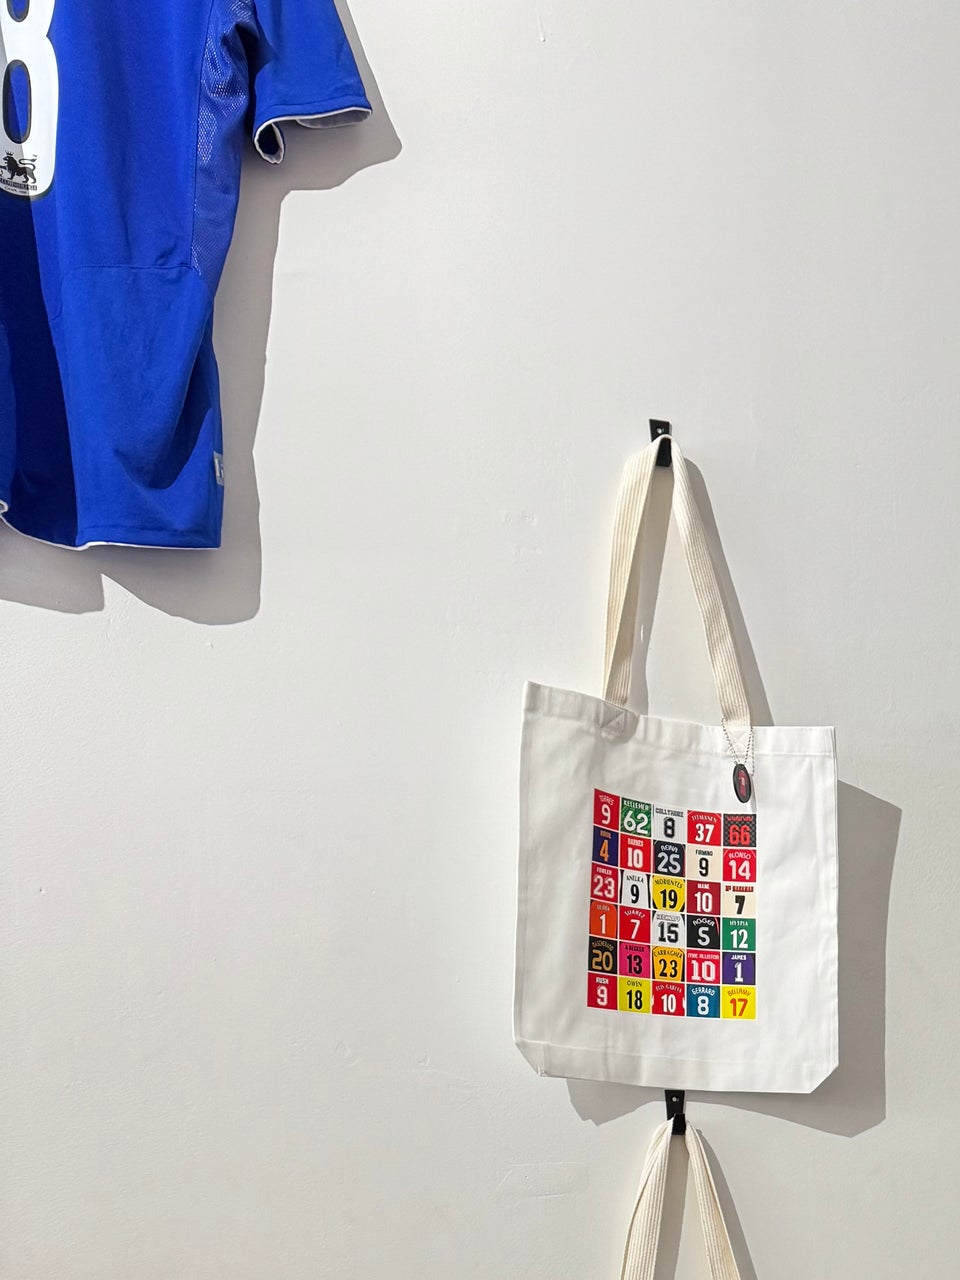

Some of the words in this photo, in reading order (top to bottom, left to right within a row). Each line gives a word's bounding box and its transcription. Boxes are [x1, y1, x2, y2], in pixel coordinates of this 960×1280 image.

[602, 804, 611, 825] 9
[624, 811, 649, 835] 62
[664, 817, 675, 838] 8
[695, 823, 714, 843] 37
[729, 824, 751, 846] 66
[600, 840, 609, 862] 4
[627, 847, 643, 869] 10
[728, 852, 751, 860] ALONSO
[657, 852, 681, 874] 25
[699, 857, 709, 877] 9
[729, 860, 751, 880] 14
[594, 874, 614, 898] 23
[630, 884, 640, 904] 9
[660, 888, 678, 909] 19
[695, 891, 713, 913] 10
[735, 895, 746, 915] 7
[600, 913, 607, 935] 1
[630, 919, 640, 939] 7
[657, 921, 679, 943] 15
[697, 927, 710, 946] 5
[730, 928, 748, 948] 12
[592, 949, 613, 971] 20
[626, 954, 643, 975] 13
[658, 959, 677, 978] 23
[691, 960, 715, 982] 10
[734, 962, 743, 982] 1
[597, 986, 608, 1006] 9
[626, 990, 643, 1010] 18
[691, 987, 715, 996] GERRARD
[661, 994, 676, 1013] 10
[697, 996, 709, 1015] 8
[729, 998, 748, 1016] 17
